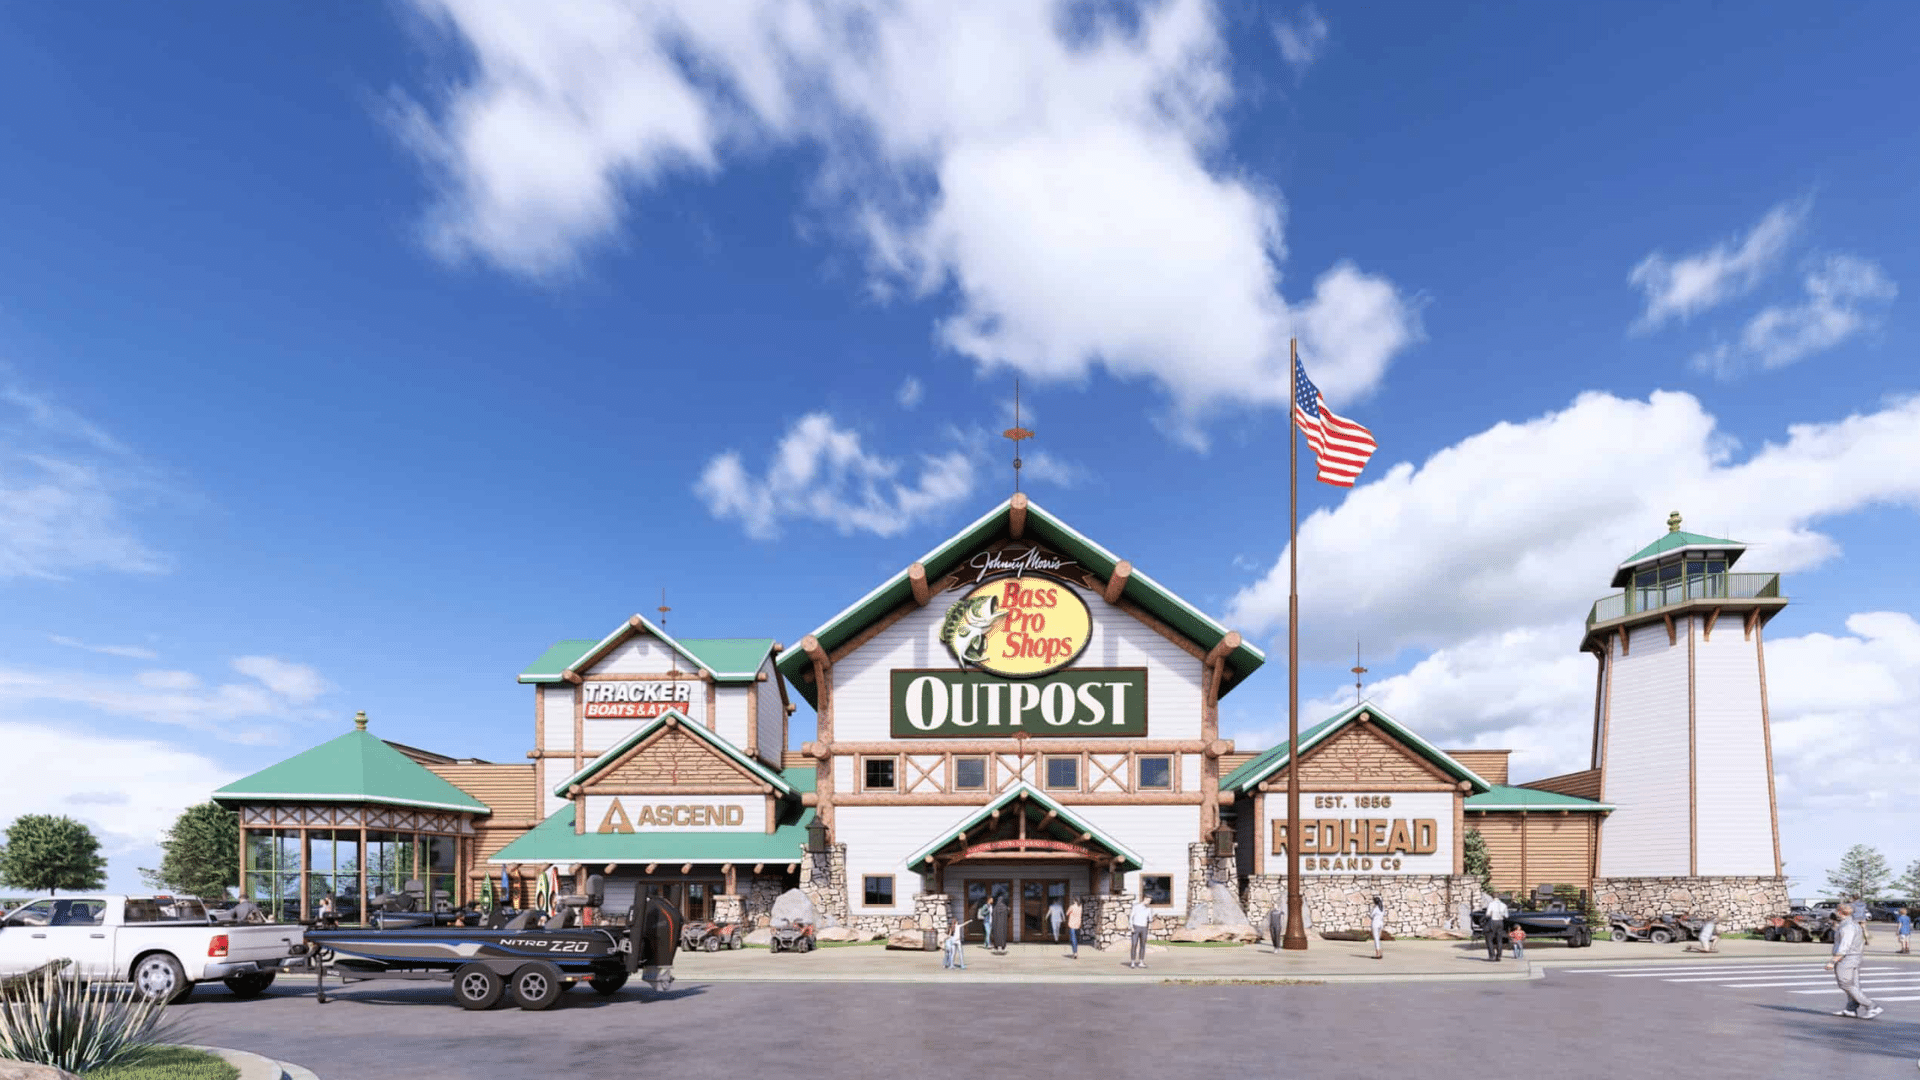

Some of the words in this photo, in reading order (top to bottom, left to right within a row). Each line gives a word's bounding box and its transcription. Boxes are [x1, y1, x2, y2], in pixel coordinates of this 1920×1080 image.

[970, 551, 1024, 582] Johnny
[1013, 546, 1077, 570] Morris
[1001, 582, 1057, 609] Bass
[1002, 609, 1045, 632] Pro
[1002, 632, 1072, 664] Shops
[585, 683, 690, 702] TRACKER
[905, 676, 1133, 730] OUTPOST
[588, 704, 635, 716] BOATS
[637, 704, 646, 715] &
[1315, 796, 1347, 808] EST.
[1355, 796, 1391, 808] 1856
[637, 805, 744, 826] ASCEND
[1305, 858, 1373, 871] BRAND
[500, 939, 548, 947] NITRO
[549, 940, 589, 953] Z20
